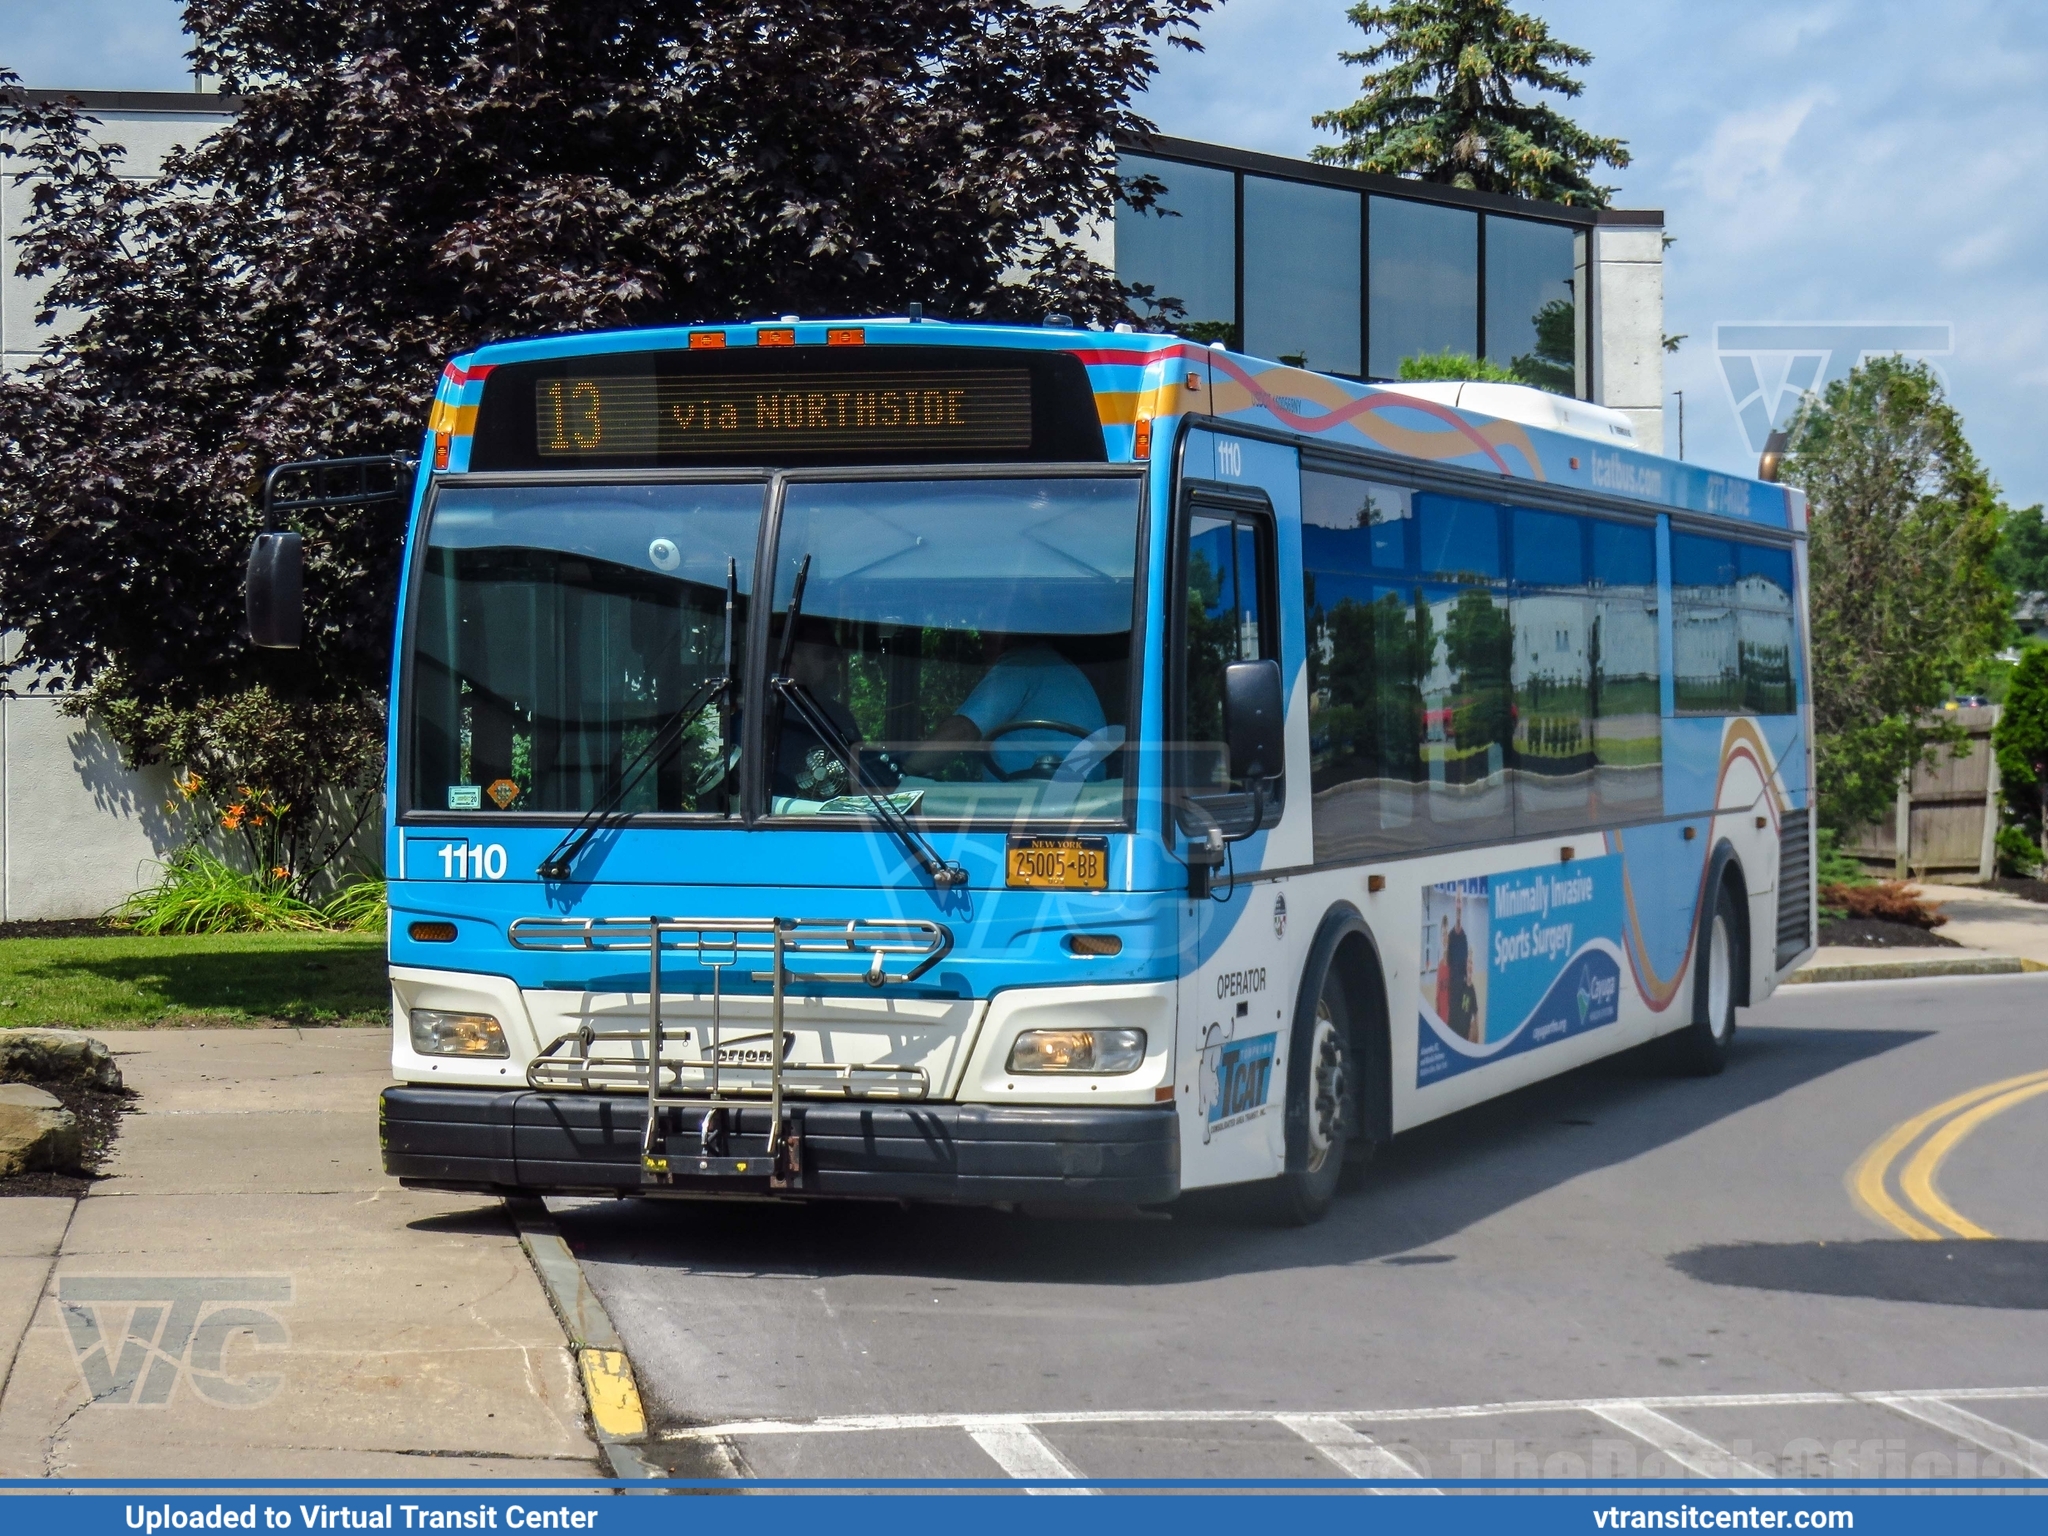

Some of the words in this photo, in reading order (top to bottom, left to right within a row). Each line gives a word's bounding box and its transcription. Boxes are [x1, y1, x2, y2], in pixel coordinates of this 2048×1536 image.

[549, 382, 601, 449] 13
[673, 400, 737, 429] via
[756, 390, 966, 428] NORTHSIDE
[1218, 440, 1241, 477] 1110
[1592, 449, 1662, 498] tcatbus.com
[438, 843, 508, 879] 1110
[1016, 850, 1066, 877] 25005
[1031, 840, 1056, 849] NEW
[1057, 840, 1083, 849] YORK
[1495, 875, 1549, 919] Minimally
[1551, 869, 1593, 908] Invasive
[1494, 927, 1531, 973] Sports
[1532, 922, 1573, 961] Surgery
[1217, 967, 1266, 1000] OPERATOR
